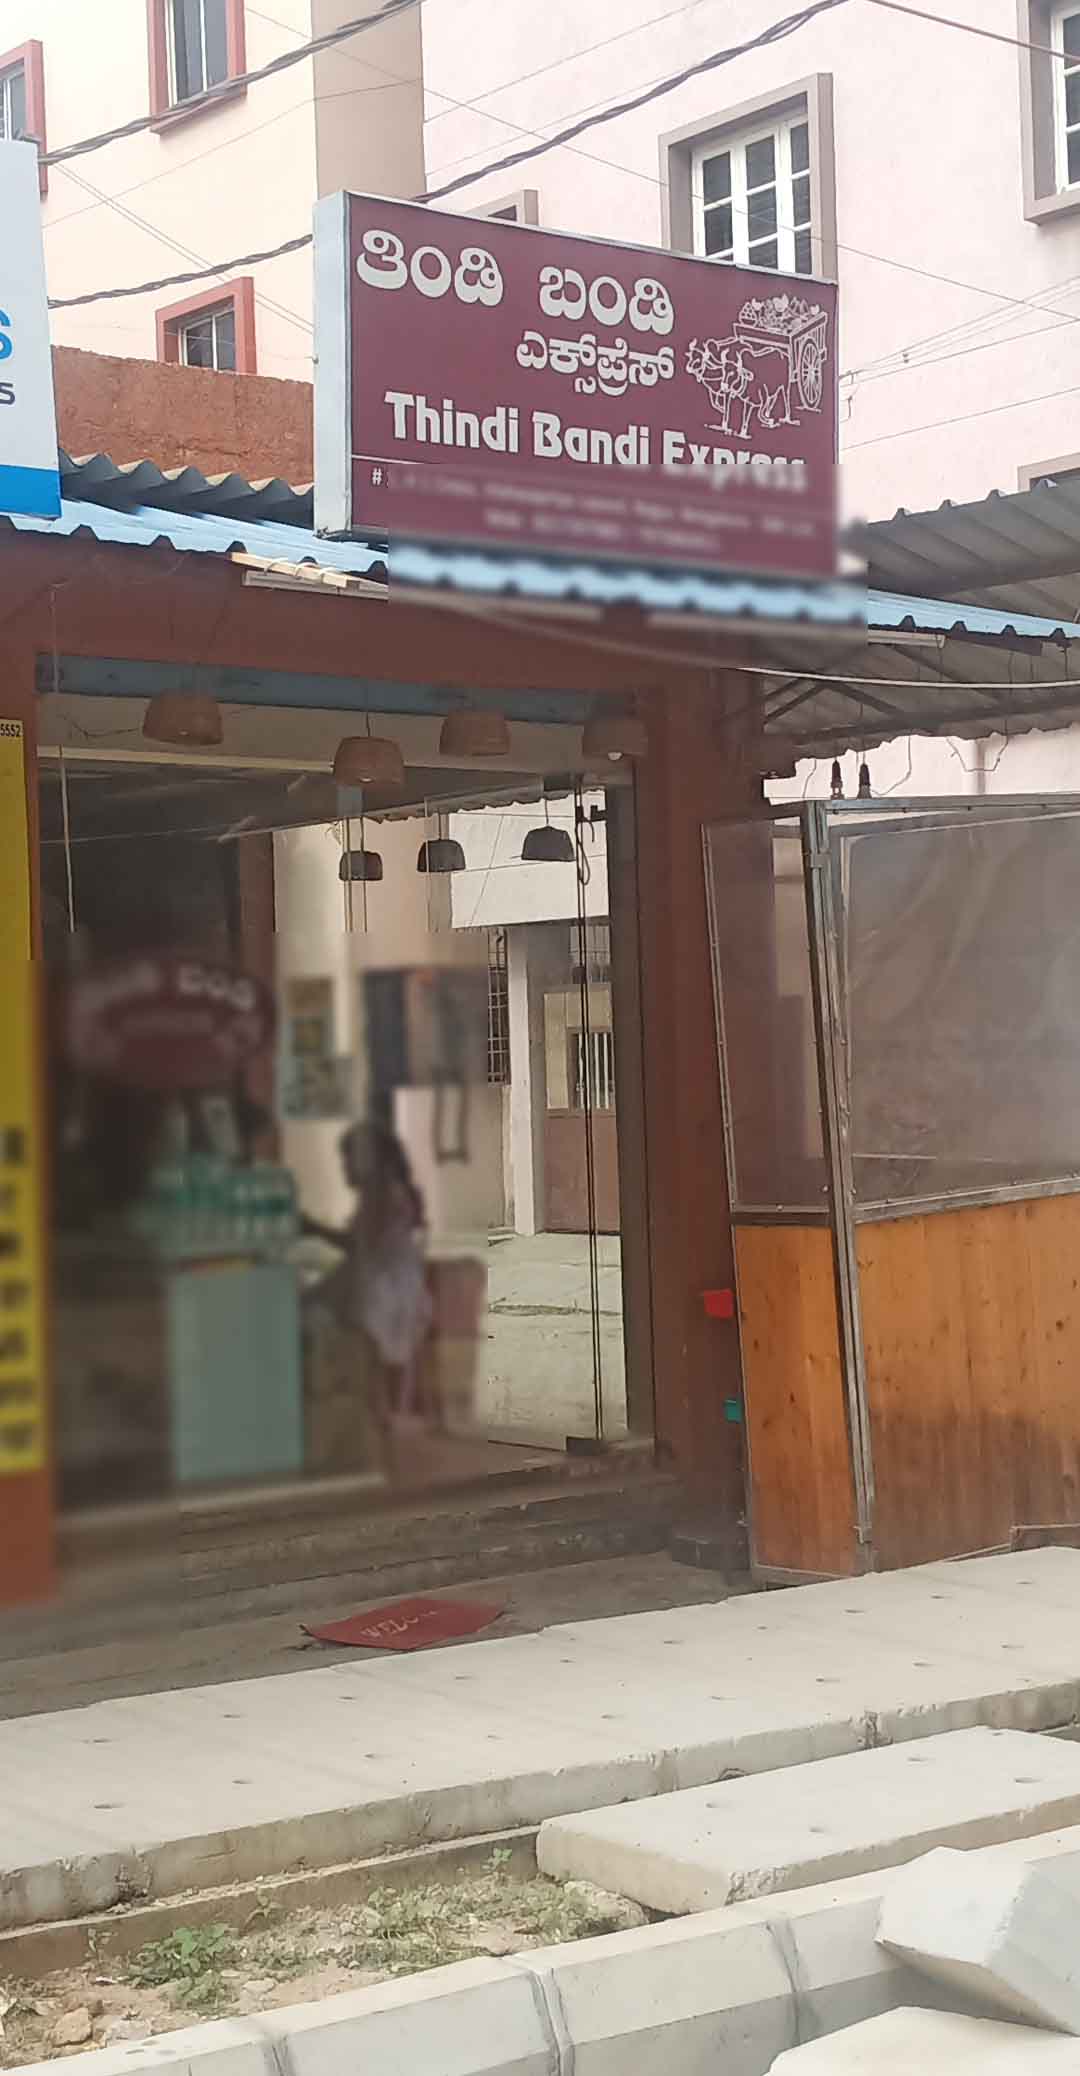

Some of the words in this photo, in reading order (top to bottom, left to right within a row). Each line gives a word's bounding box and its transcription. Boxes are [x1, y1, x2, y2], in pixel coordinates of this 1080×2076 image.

[356, 229, 504, 306] ತಿಂಡಿ
[539, 266, 675, 335] ಬಂಡಿ
[384, 391, 519, 453] Thindi
[532, 411, 649, 467] Bandi
